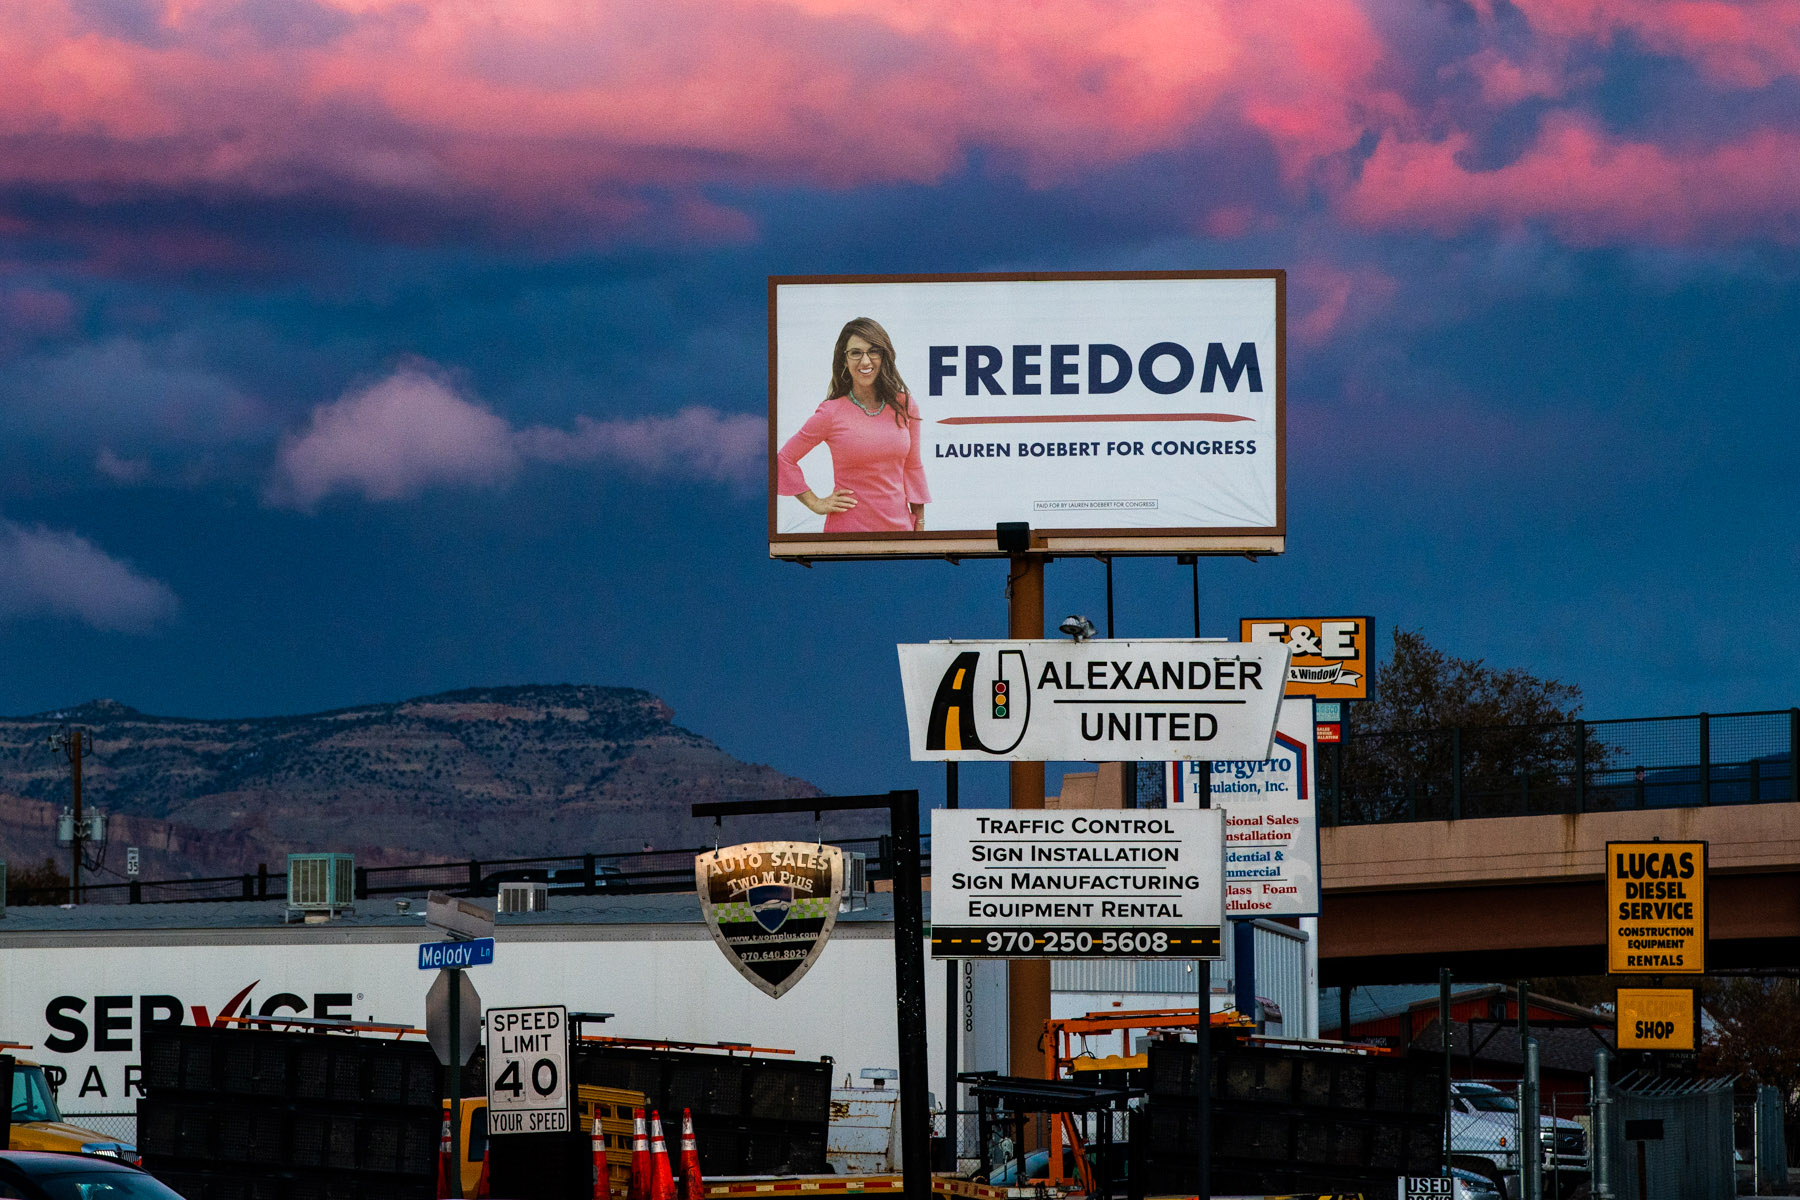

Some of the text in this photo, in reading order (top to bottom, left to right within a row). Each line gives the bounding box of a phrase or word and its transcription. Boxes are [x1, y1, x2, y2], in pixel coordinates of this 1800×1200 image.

[928, 341, 1264, 397] FREEDOM
[935, 439, 1257, 459] LAUREN BOEBERT FOR CONGRESS
[1037, 660, 1263, 691] ALEXANDER
[1290, 669, 1297, 679] &
[1081, 712, 1219, 742] UNITED
[1193, 780, 1289, 795] Isulation, Inc.
[976, 817, 1175, 834] TRAFFIC CONTROL
[1226, 814, 1299, 826] sional Sales
[1226, 829, 1292, 841] nstallation
[971, 845, 1179, 862] SIGN INSTALLATION
[1226, 850, 1284, 862] idential &
[709, 852, 829, 878] AUTO SALES
[1226, 866, 1281, 877] mmercial
[1616, 852, 1695, 880] LUCAS
[727, 870, 814, 892] TWO M PLUS
[951, 872, 1200, 890] SIGN MANUFACTURING
[1262, 883, 1298, 895] Foam
[1626, 881, 1687, 900] DIESEL
[968, 900, 1183, 918] EQUIPMENT RENTAL
[1225, 899, 1273, 910] ellulose
[1619, 902, 1694, 920] SERVICE
[1618, 926, 1694, 937] CONSTRUCTION
[985, 931, 1169, 952] 970-250-5608
[1627, 939, 1685, 950] EQUIPMENT
[422, 944, 491, 967] Melody Ln
[741, 948, 808, 961] 970.640.8029
[1627, 954, 1684, 966] RENTALS
[965, 959, 973, 1032] 03038
[494, 1011, 560, 1032] SPEED
[1635, 1020, 1675, 1040] SHOP
[502, 1034, 552, 1054] LIMIT
[494, 1057, 558, 1098] 40
[491, 1112, 565, 1132] YOUR SPEED
[1408, 1177, 1452, 1193] USED
